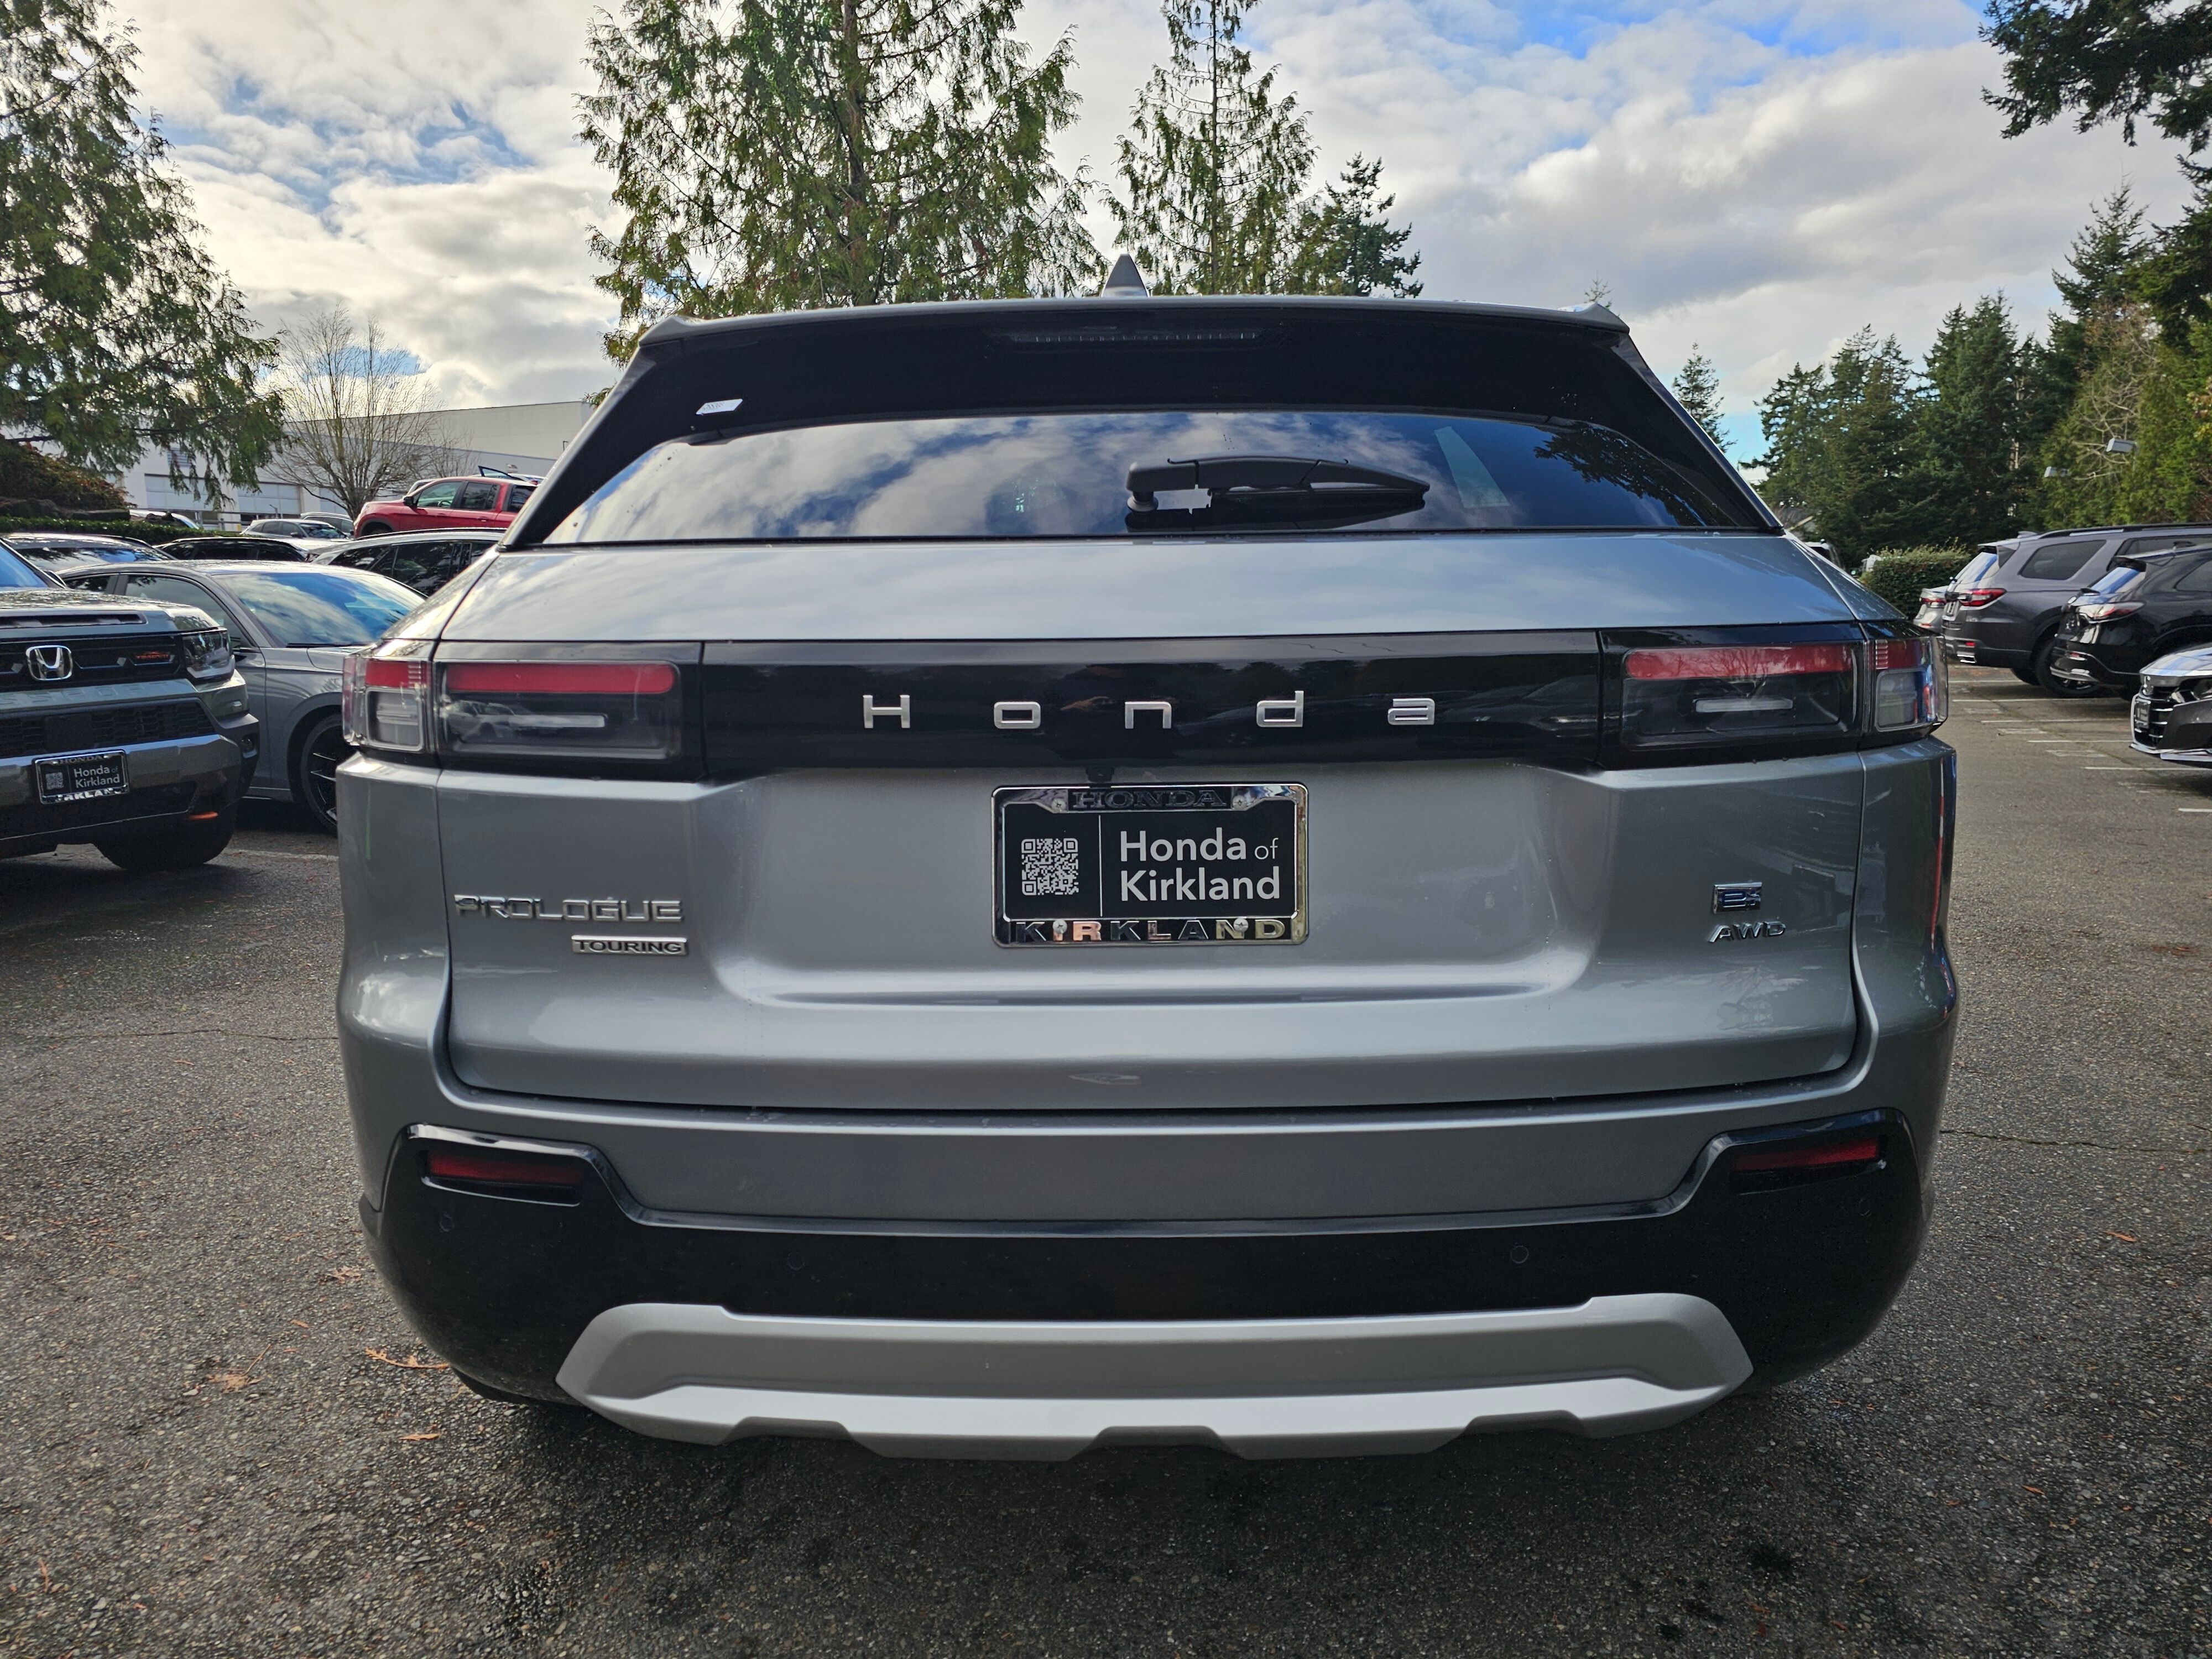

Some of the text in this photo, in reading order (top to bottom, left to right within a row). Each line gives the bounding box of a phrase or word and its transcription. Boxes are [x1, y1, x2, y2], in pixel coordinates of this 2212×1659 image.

[862, 690, 1436, 730] Honda
[59, 755, 103, 764] HONDA
[74, 765, 110, 778] Honda
[76, 774, 120, 788] Kirkland
[1072, 790, 1227, 810] HONDA
[1120, 827, 1279, 862] Honda of
[1120, 867, 1280, 901] Kirkland
[453, 894, 684, 921] PROLOGUE
[1708, 920, 1786, 943] AWD
[575, 940, 682, 953] TOURING
